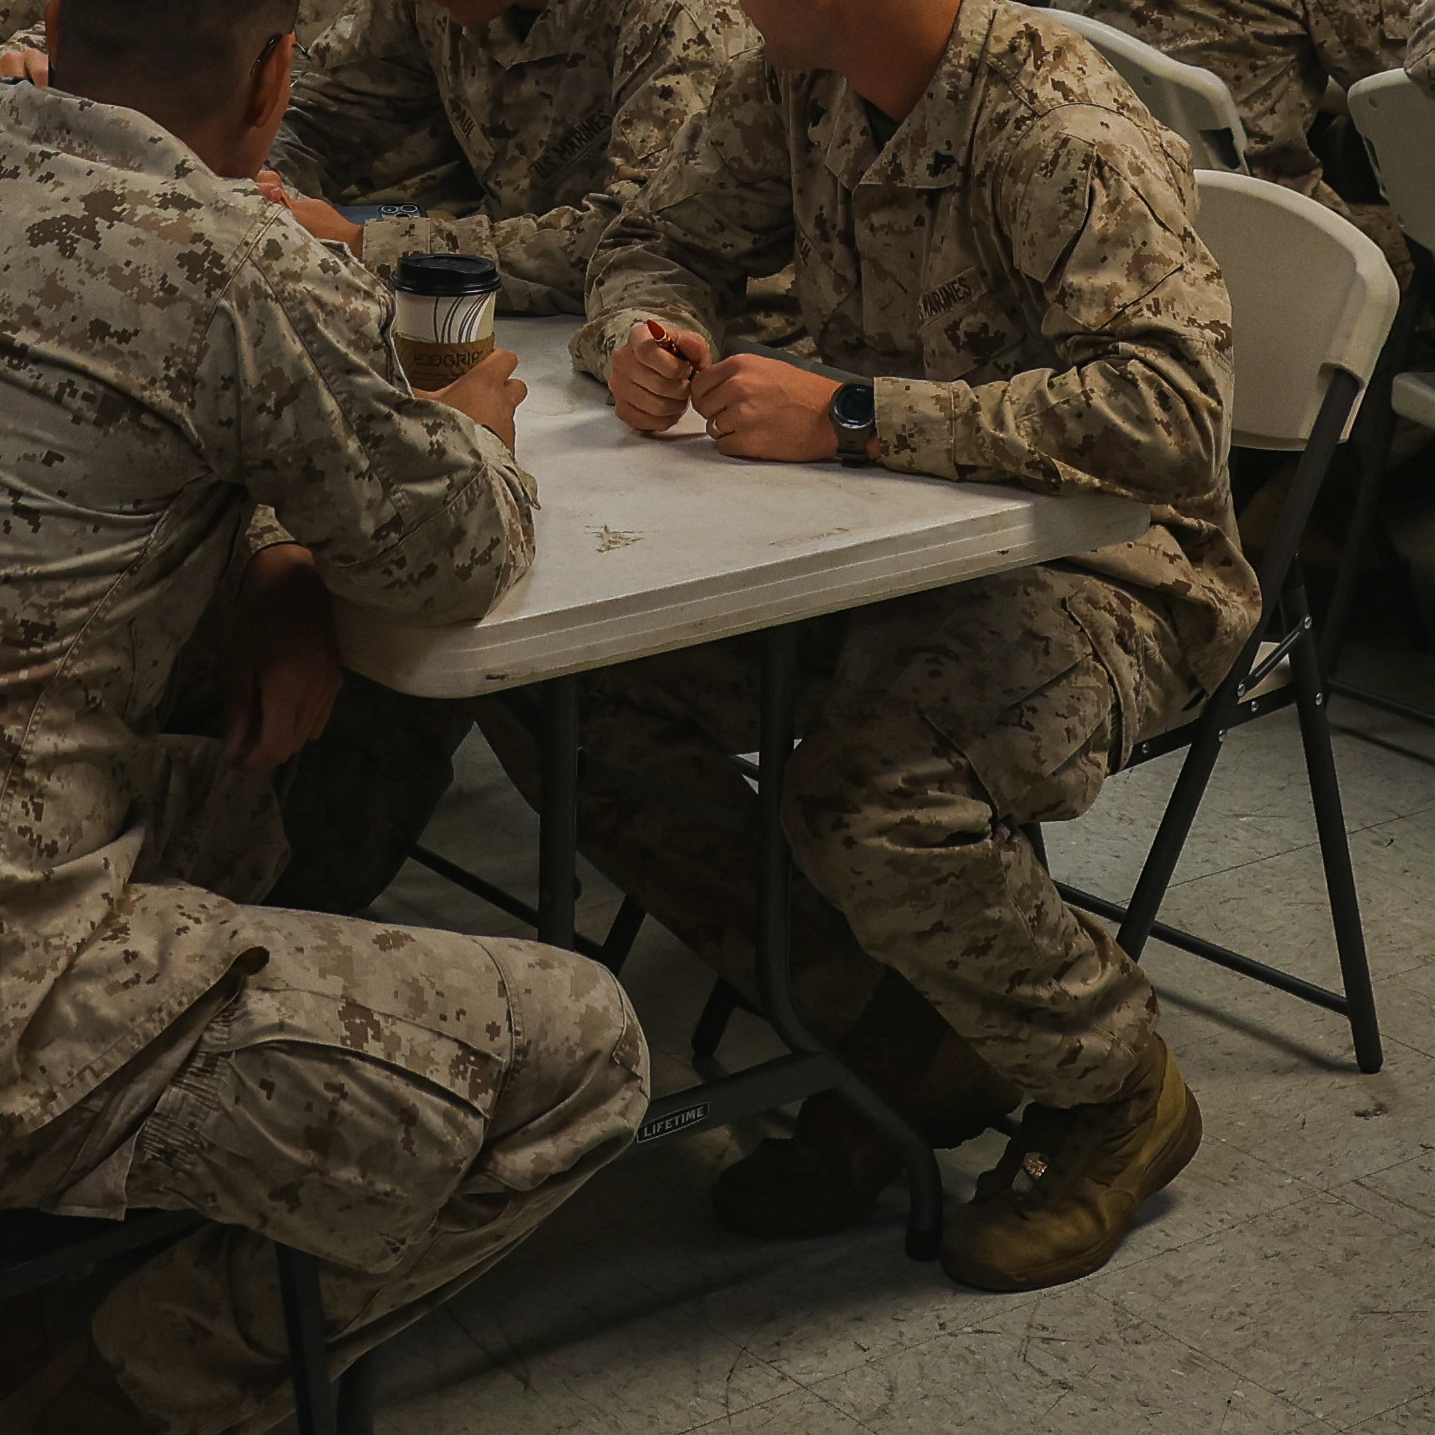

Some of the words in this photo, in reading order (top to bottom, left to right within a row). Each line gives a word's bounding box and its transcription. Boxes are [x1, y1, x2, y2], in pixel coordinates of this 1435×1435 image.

[559, 108, 613, 161] MARINES
[923, 276, 973, 318] MARINES
[644, 1106, 704, 1138] LIFETIME
